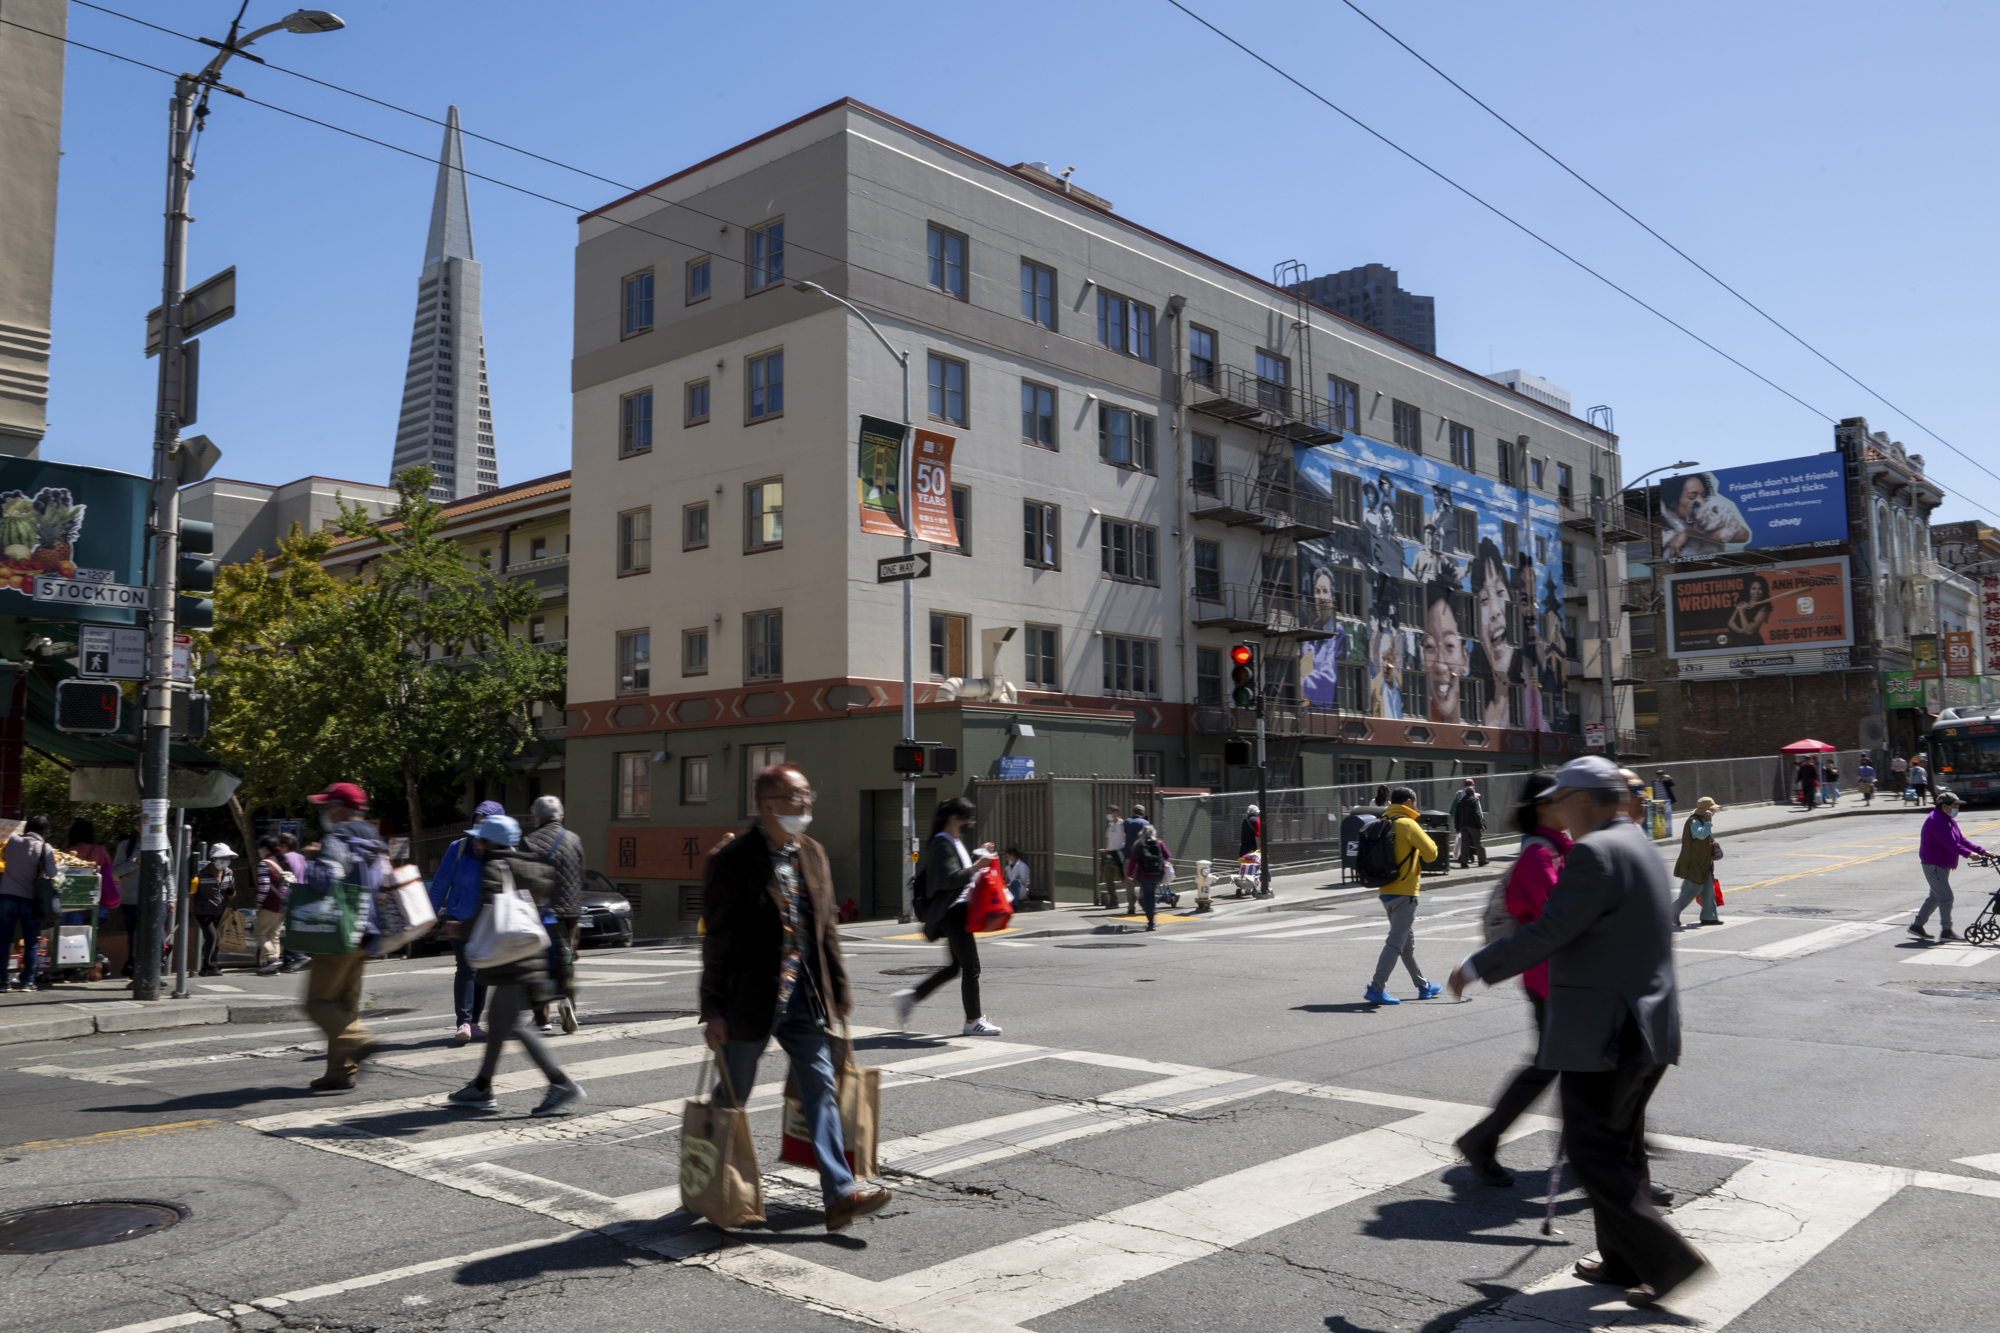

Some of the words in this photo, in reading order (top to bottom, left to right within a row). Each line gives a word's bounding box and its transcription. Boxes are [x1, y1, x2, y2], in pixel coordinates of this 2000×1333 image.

[916, 463, 946, 496] 50
[1728, 480, 1763, 492] Friends
[1764, 476, 1789, 487] don't
[1790, 475, 1804, 483] let
[1805, 470, 1839, 481] friends
[917, 492, 947, 507] YEARS
[1740, 491, 1757, 502] get
[1758, 489, 1780, 498] fleas
[1782, 485, 1800, 495] and
[1801, 482, 1828, 492] ticks.
[1747, 503, 1775, 512] America's
[1794, 499, 1822, 507] Pharmacy
[1768, 517, 1802, 528] chewy
[87, 570, 113, 581] 1200
[882, 564, 897, 576] ONE
[899, 562, 915, 573] WAY
[1677, 578, 1744, 596] SOMETHING
[1772, 578, 1793, 590] ANH
[41, 582, 145, 604] STOCKTON
[1677, 592, 1740, 612] WRONG?
[1778, 615, 1814, 624] PHOONG
[1816, 613, 1836, 621] LAW
[1769, 625, 1842, 640] 866-GOT-PAIN
[1949, 645, 1969, 658] 50
[102, 693, 116, 722] 4
[1945, 728, 1957, 737] 30
[914, 751, 923, 767] 4
